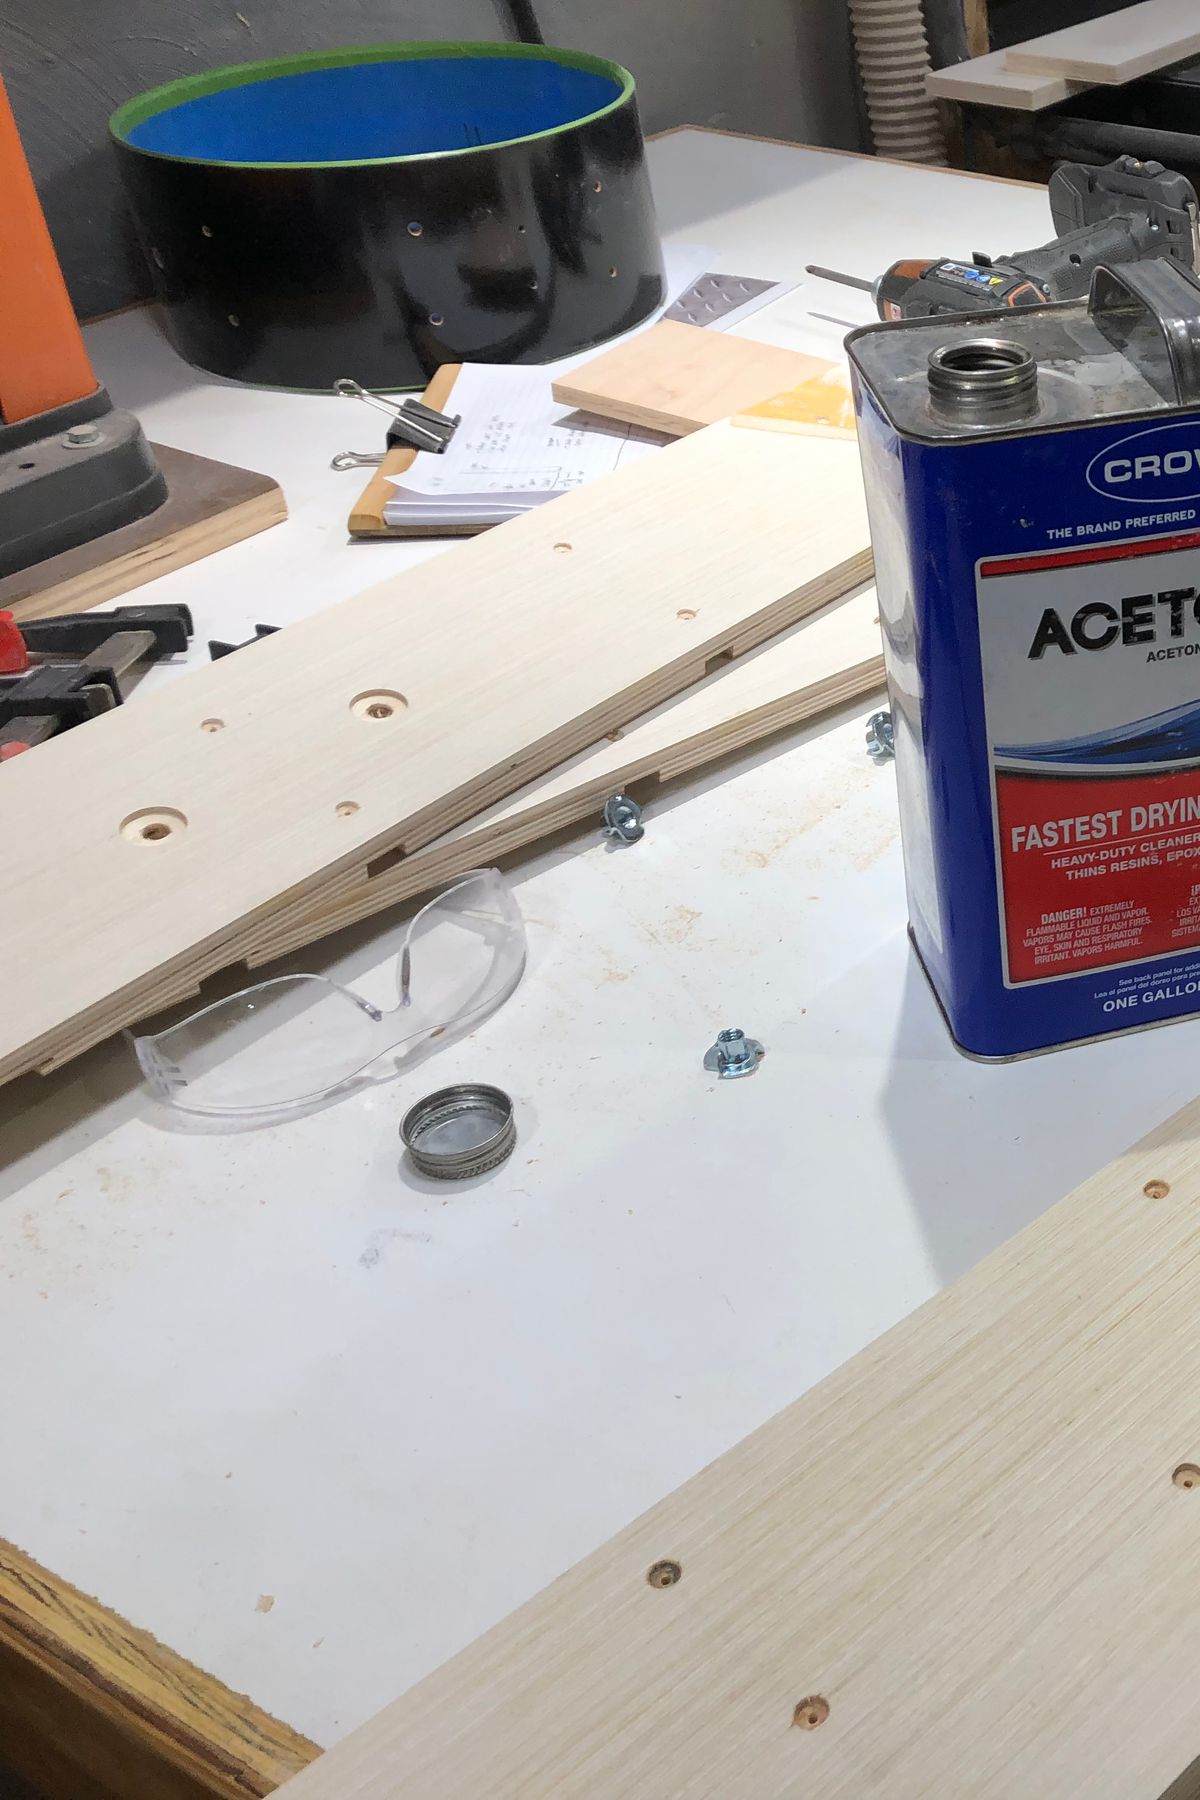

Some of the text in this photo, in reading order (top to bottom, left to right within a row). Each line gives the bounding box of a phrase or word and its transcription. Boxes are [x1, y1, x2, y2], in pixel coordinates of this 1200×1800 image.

[1047, 529, 1073, 540] THE
[1077, 520, 1121, 536] BRAND
[1125, 509, 1196, 529] PREFERRED
[1011, 810, 1122, 852] FASTEST
[1051, 843, 1136, 869] HEAVY-DUTY
[1066, 866, 1107, 880] THINS
[1110, 854, 1163, 873] RESINS,
[1041, 900, 1135, 925] DANGER! EXTREMELY
[1176, 907, 1192, 918] LOS
[1023, 935, 1055, 947] VAPORS
[1056, 932, 1073, 941] MAY
[1075, 927, 1101, 938] CAUSE
[1102, 921, 1128, 933] FLASH
[1026, 922, 1075, 937] FLAMMABLE
[1077, 917, 1102, 929] LIQUID
[1103, 914, 1121, 923] AND
[1053, 942, 1072, 952] SKIN
[1073, 938, 1090, 948] AND
[1091, 927, 1144, 945] RESPIRATORY
[1072, 946, 1103, 958] VAPORS
[1118, 977, 1132, 986] See
[1134, 973, 1151, 984] back
[1152, 968, 1173, 981] panel
[1173, 966, 1184, 975] for
[1102, 993, 1138, 1012] ONE
